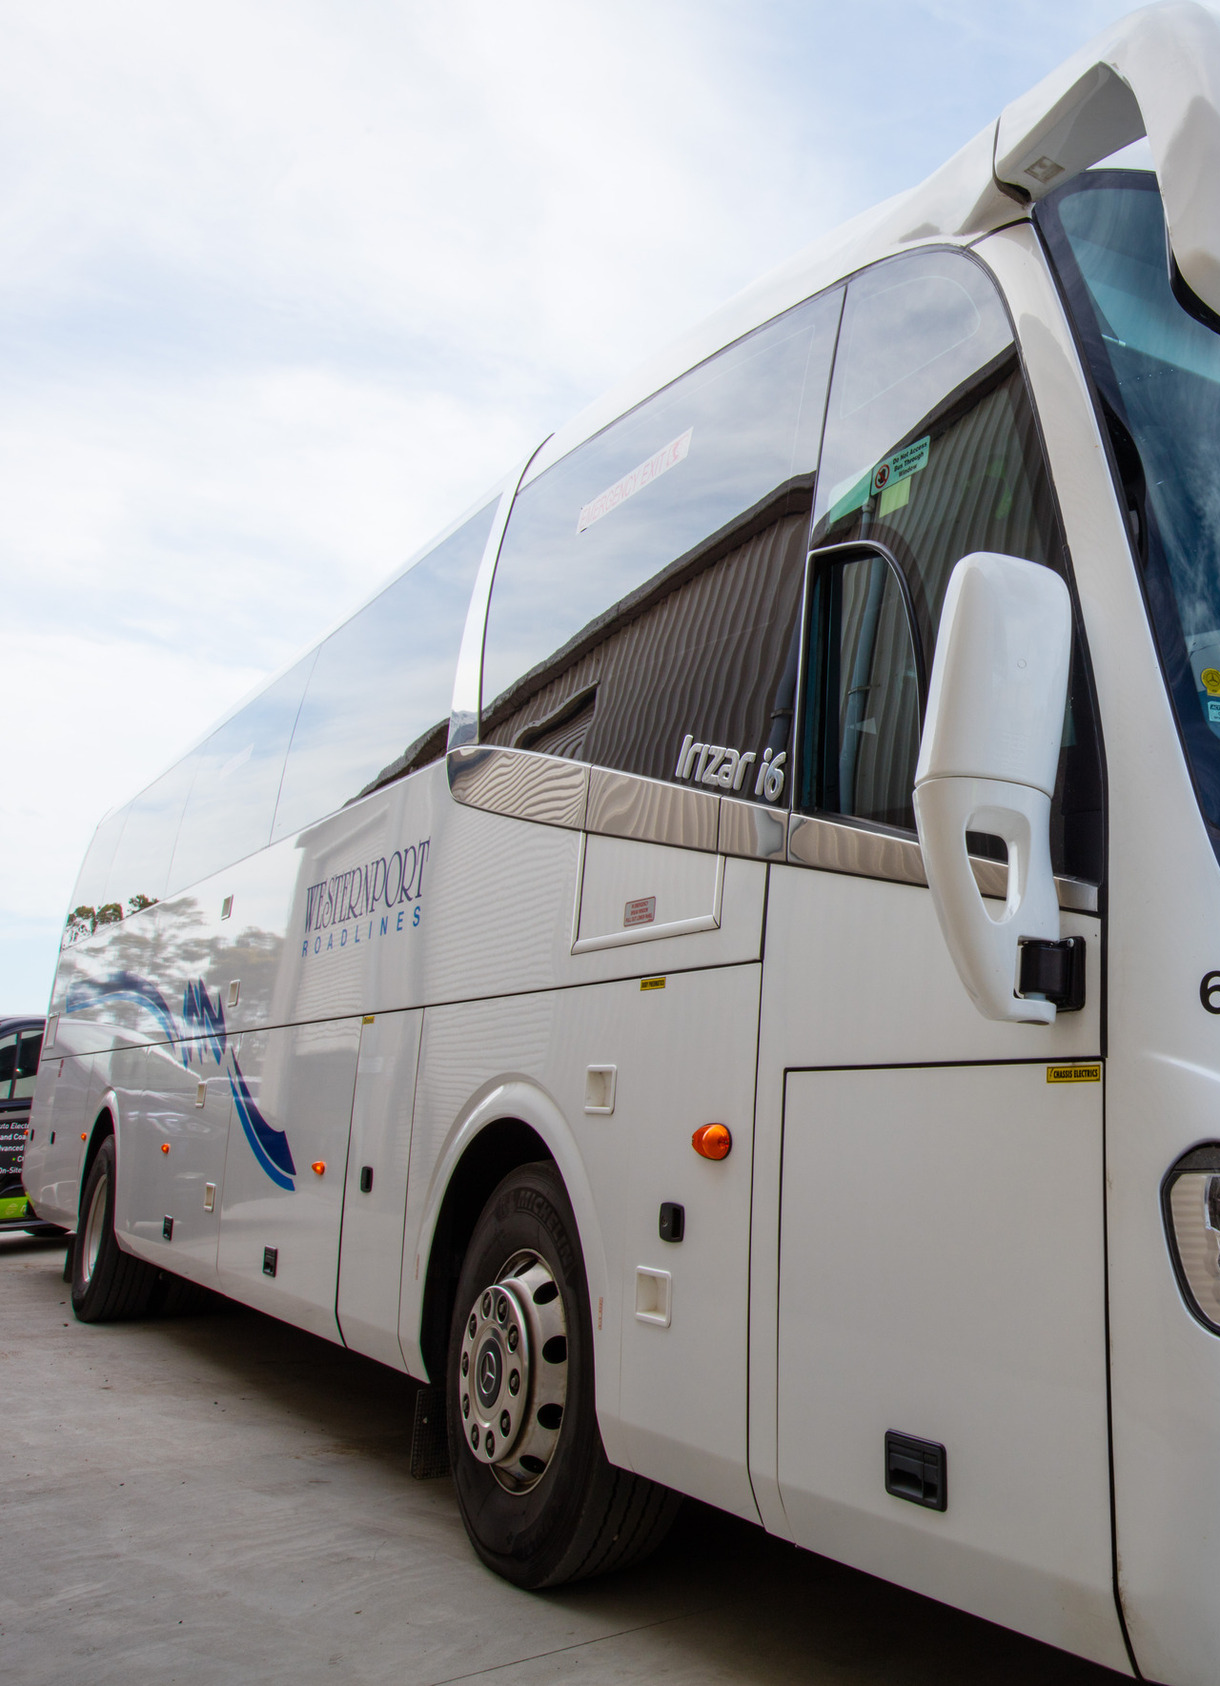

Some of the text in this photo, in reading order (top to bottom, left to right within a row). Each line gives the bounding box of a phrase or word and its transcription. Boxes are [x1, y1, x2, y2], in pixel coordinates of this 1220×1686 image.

[909, 442, 927, 454] Access
[579, 450, 667, 530] EMERGENCY EXIT
[675, 734, 787, 802] Irizar i6
[305, 835, 432, 934] WESTERNPORT
[302, 905, 421, 958] ROADLINES
[1053, 1068, 1098, 1079] CHASSIS ELECTRICS
